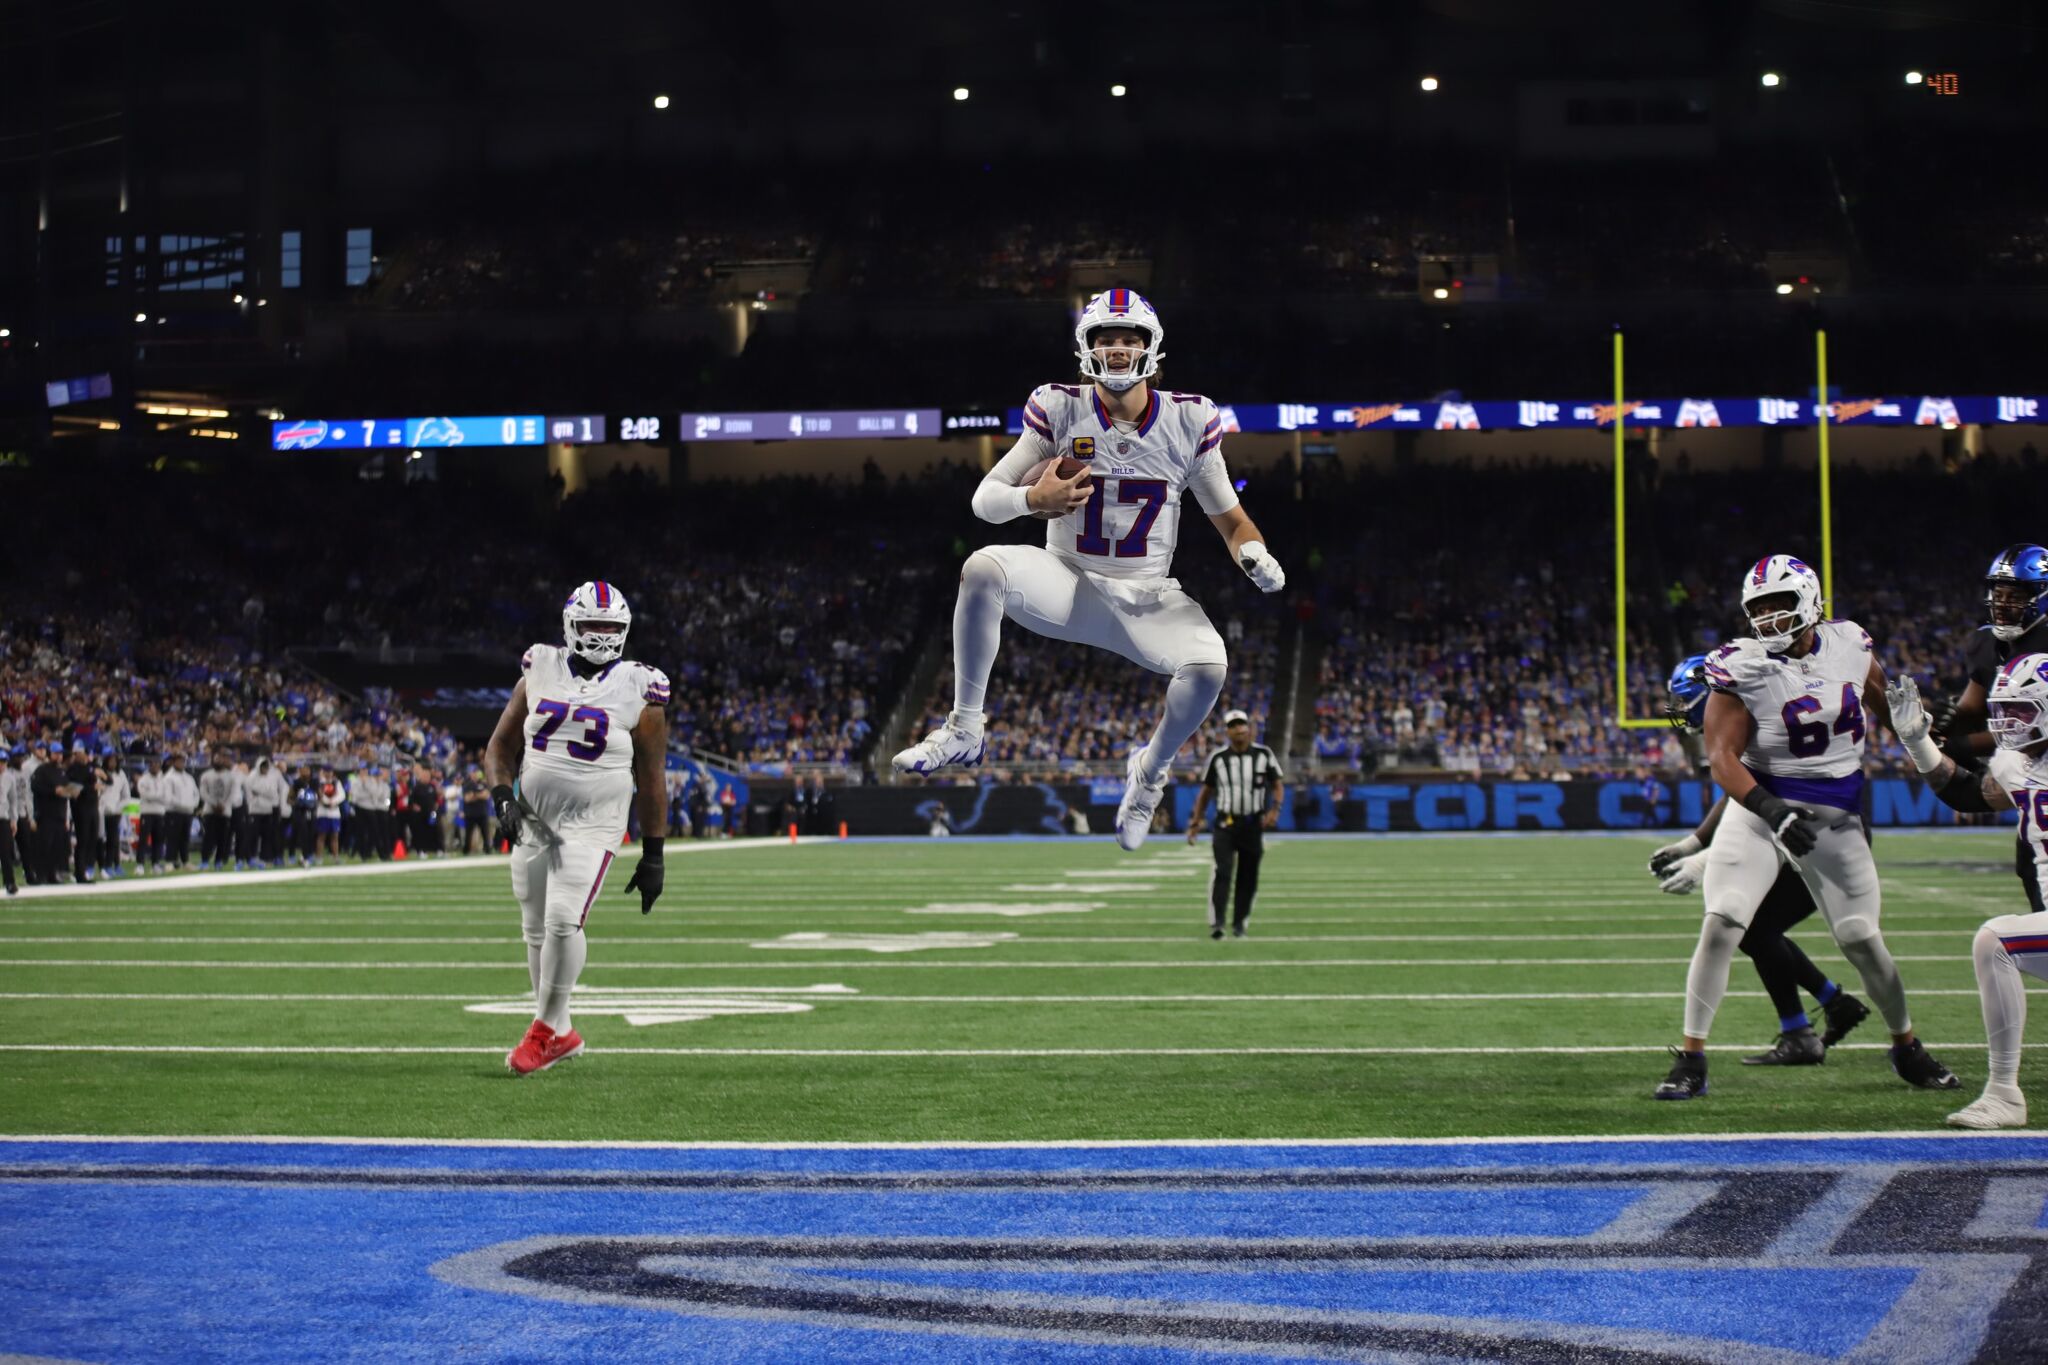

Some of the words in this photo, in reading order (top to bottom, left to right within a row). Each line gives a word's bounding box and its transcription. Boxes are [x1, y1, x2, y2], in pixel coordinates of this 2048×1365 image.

[1926, 73, 1959, 94] 40
[502, 418, 517, 444] 0
[581, 417, 593, 441] 1
[621, 417, 660, 440] 2:02
[789, 415, 802, 436] 4
[904, 413, 918, 434] 4
[959, 416, 1001, 427] DELTA
[362, 420, 376, 447] 7
[1074, 438, 1094, 454] C
[1111, 467, 1135, 475] BILLS
[1076, 476, 1168, 558] 17
[532, 698, 609, 762] 73
[1782, 682, 1865, 758] 64
